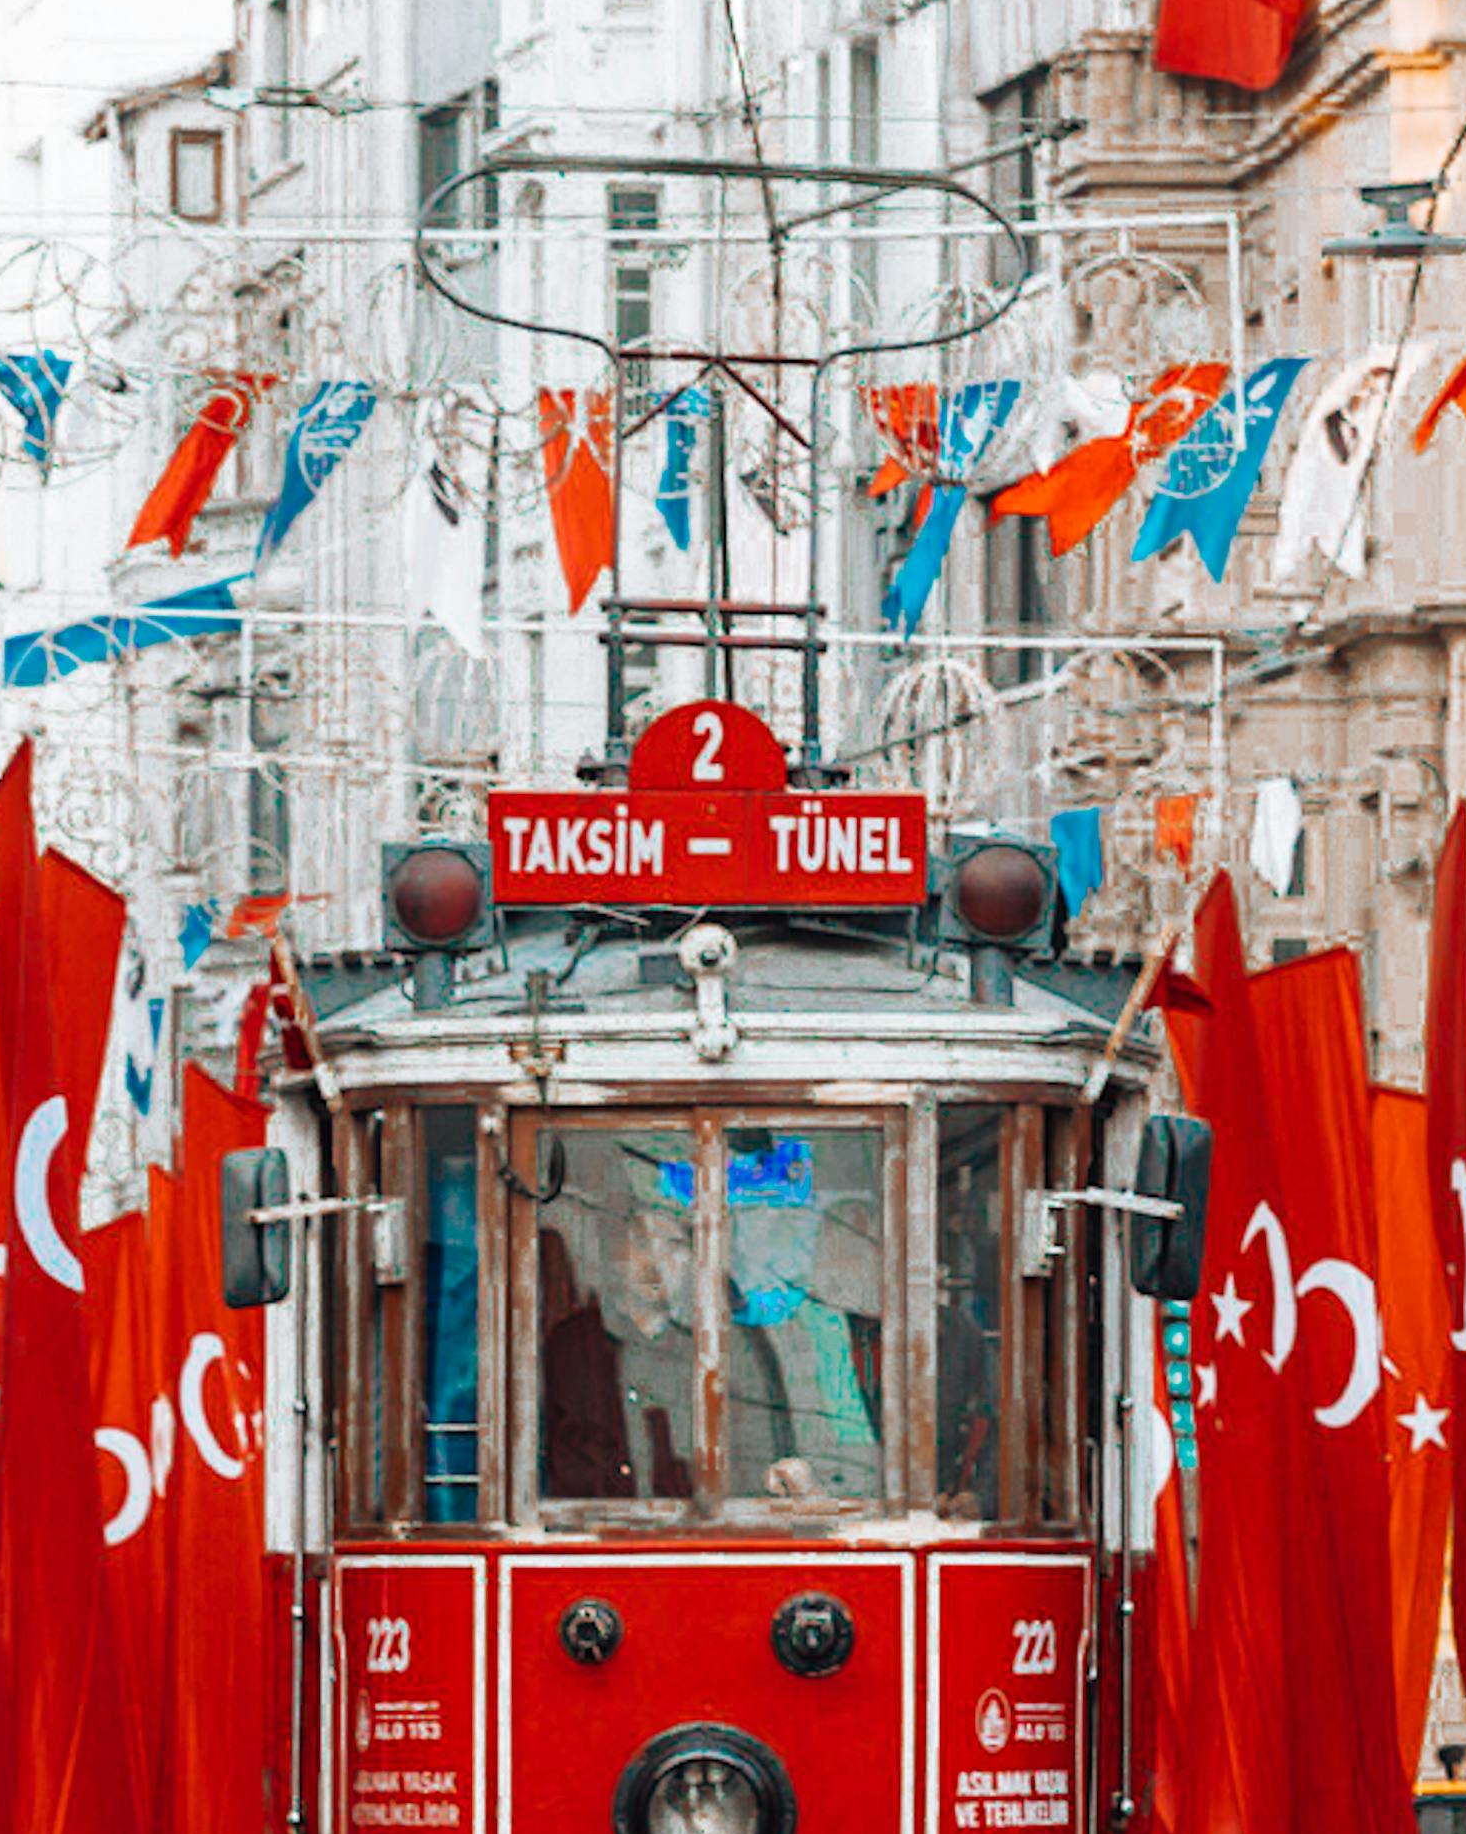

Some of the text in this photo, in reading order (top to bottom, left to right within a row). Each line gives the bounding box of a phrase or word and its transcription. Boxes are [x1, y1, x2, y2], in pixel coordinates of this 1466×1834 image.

[691, 710, 724, 782] 2
[502, 802, 665, 876] TAKSİM
[768, 800, 913, 873] TÜNEL
[365, 1616, 411, 1673] 223
[1011, 1619, 1057, 1675] 223
[954, 1801, 980, 1828] VE
